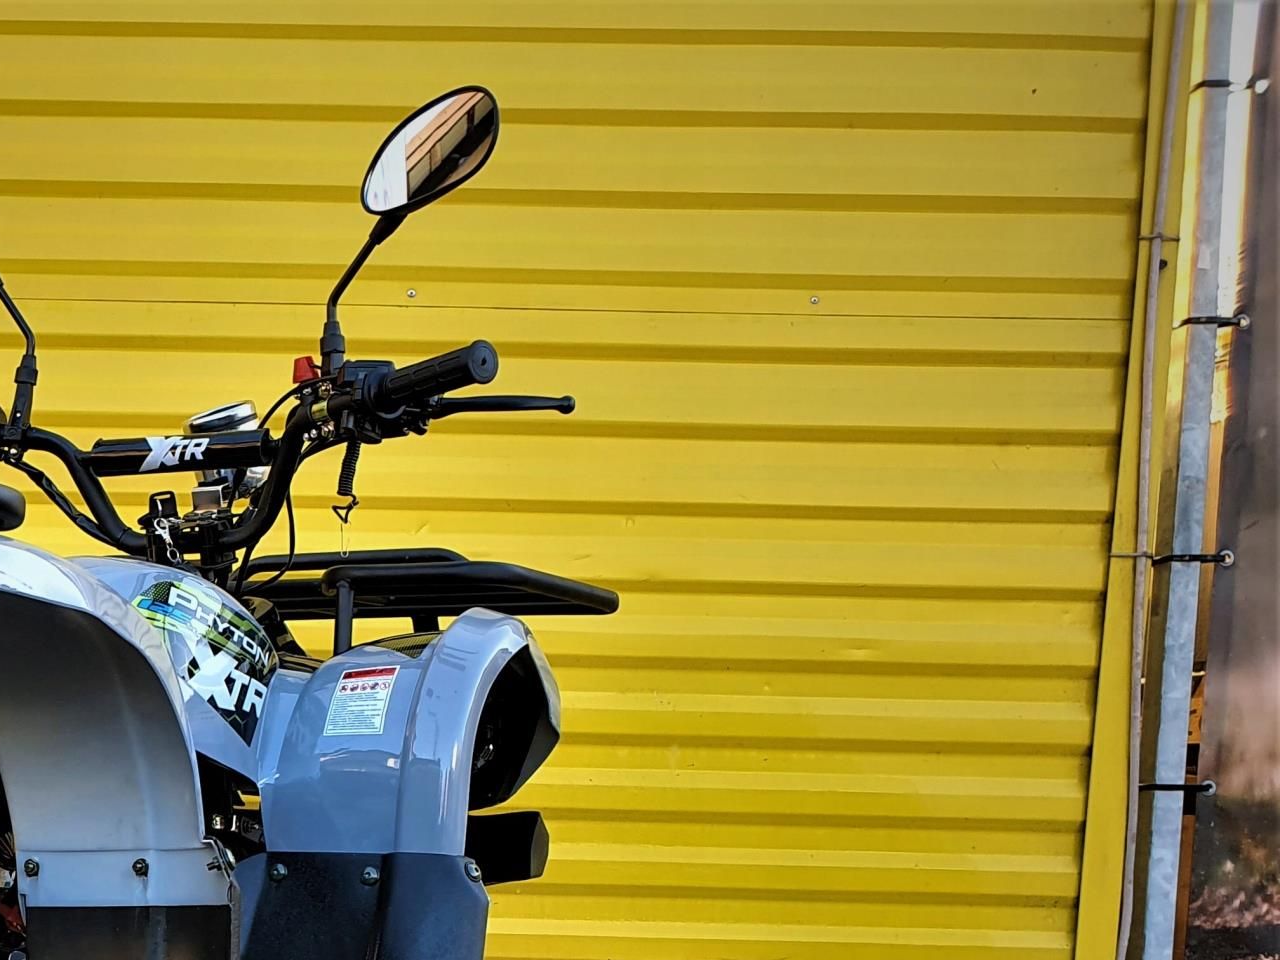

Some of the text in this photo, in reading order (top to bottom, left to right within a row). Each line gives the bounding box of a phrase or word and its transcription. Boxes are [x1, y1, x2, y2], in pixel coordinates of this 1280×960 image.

[139, 436, 210, 472] XTR
[167, 586, 269, 667] PHYTON
[178, 622, 268, 718] XTR
